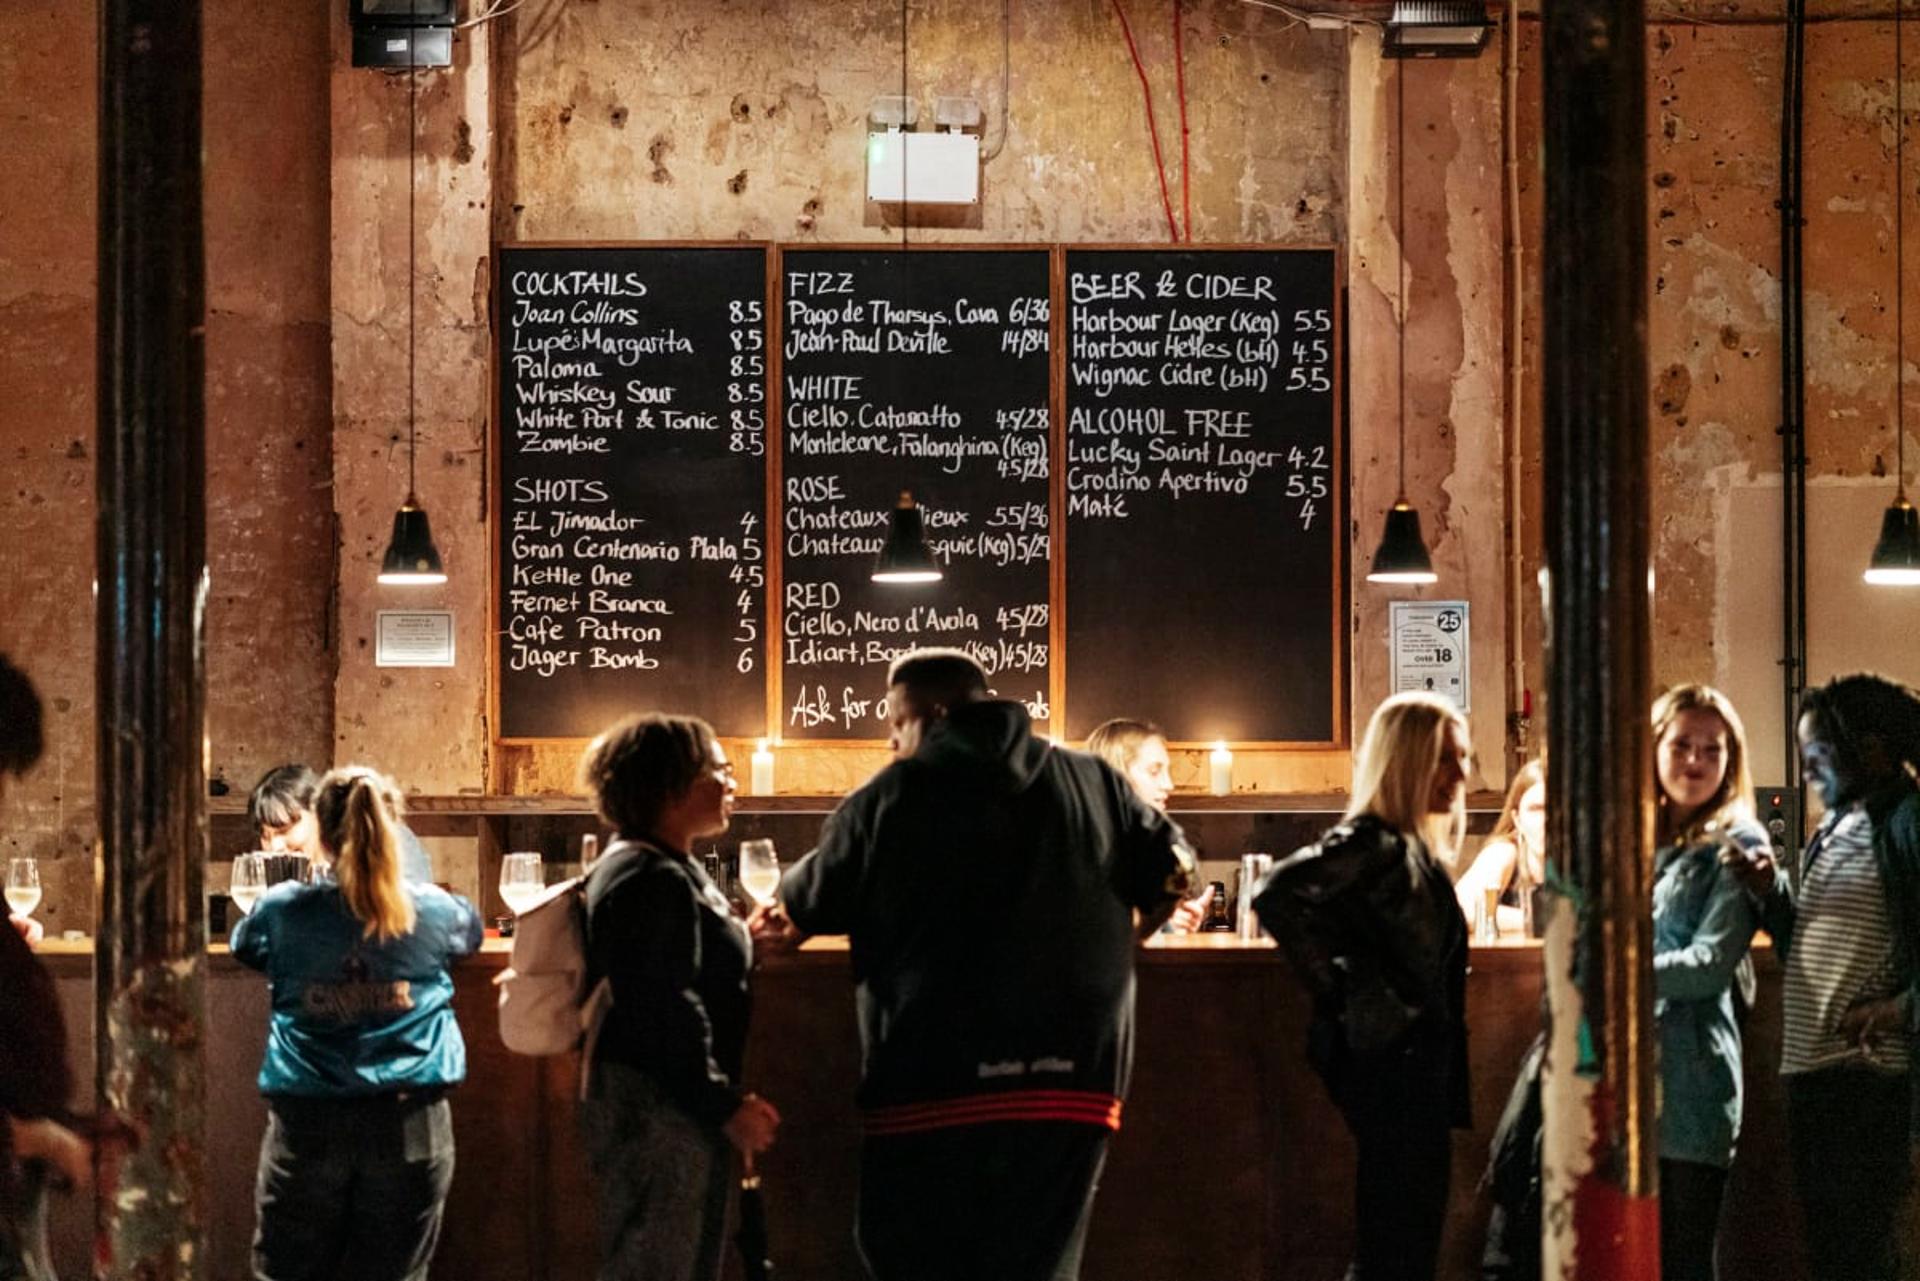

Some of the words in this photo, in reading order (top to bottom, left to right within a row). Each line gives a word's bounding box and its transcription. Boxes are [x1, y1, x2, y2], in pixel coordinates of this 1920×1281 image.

[512, 271, 647, 296] COCKTAILS
[788, 272, 855, 297] FIZZ
[1071, 271, 1146, 303] BEER
[1156, 269, 1178, 297] &
[1186, 273, 1277, 301] CIDER
[512, 300, 564, 327] Joan
[570, 300, 639, 325] Collins
[787, 300, 838, 336] Pago
[842, 299, 864, 323] de
[955, 298, 999, 324] Cava
[1009, 297, 1049, 327] 6/36
[1073, 306, 1162, 333] Harbour
[1168, 308, 1226, 345] Lager
[1230, 309, 1279, 341] (Keg)
[582, 328, 694, 367] Margarita
[1001, 328, 1049, 359] 14/84
[1073, 333, 1161, 359] Harbour
[1292, 340, 1329, 364] 4.5
[512, 355, 603, 379] Paloma
[1072, 362, 1152, 397] Wignac
[1160, 361, 1216, 387] Cidre
[1286, 367, 1331, 393] 5.5
[516, 381, 616, 410] Whiskey
[626, 380, 677, 404] Sour
[728, 383, 764, 403] 8.5
[788, 376, 863, 400] WHITE
[516, 406, 578, 430] White
[581, 407, 624, 430] Port
[636, 408, 656, 430] &
[659, 411, 720, 430] Tonic
[1068, 406, 1177, 436] ALCOHOL
[1184, 408, 1253, 438] FREE
[516, 431, 612, 454] Zombie
[729, 432, 764, 455] 8.5
[1002, 433, 1047, 460] (Keg)
[1068, 438, 1140, 474] Lucky
[1148, 438, 1210, 464] Saint
[1217, 443, 1283, 477] Lager
[1287, 446, 1329, 470] 4.2
[512, 477, 609, 503] SHOTS
[787, 475, 846, 502] ROSE
[1067, 467, 1150, 492] Crodino
[1158, 467, 1248, 500] Apertivo
[1285, 474, 1328, 498] 5.5
[550, 509, 646, 537] Jimador
[740, 511, 758, 535] 4
[786, 506, 890, 530] Chateaux
[1068, 493, 1130, 518] Maté
[1299, 498, 1316, 531] 4
[512, 535, 564, 560] Gran
[574, 535, 681, 561] Centenario
[743, 538, 762, 561] 5
[512, 564, 583, 587] Kettle
[591, 564, 633, 587] One
[729, 564, 764, 588] 4.5
[509, 590, 581, 613] Fernet
[589, 589, 675, 615] Branca
[737, 589, 753, 615] 4
[786, 582, 841, 609] RED
[510, 615, 564, 645] Cafe
[576, 616, 662, 642] Patron
[733, 618, 757, 642] 5
[854, 610, 900, 632] Nero
[905, 606, 979, 632] d'Avola
[1439, 613, 1460, 630] 25
[510, 644, 581, 677] Jager
[589, 647, 659, 669] Bomb
[737, 647, 753, 673] 6
[1434, 648, 1453, 663] 18
[790, 684, 836, 728] Ask
[840, 685, 871, 730] for
